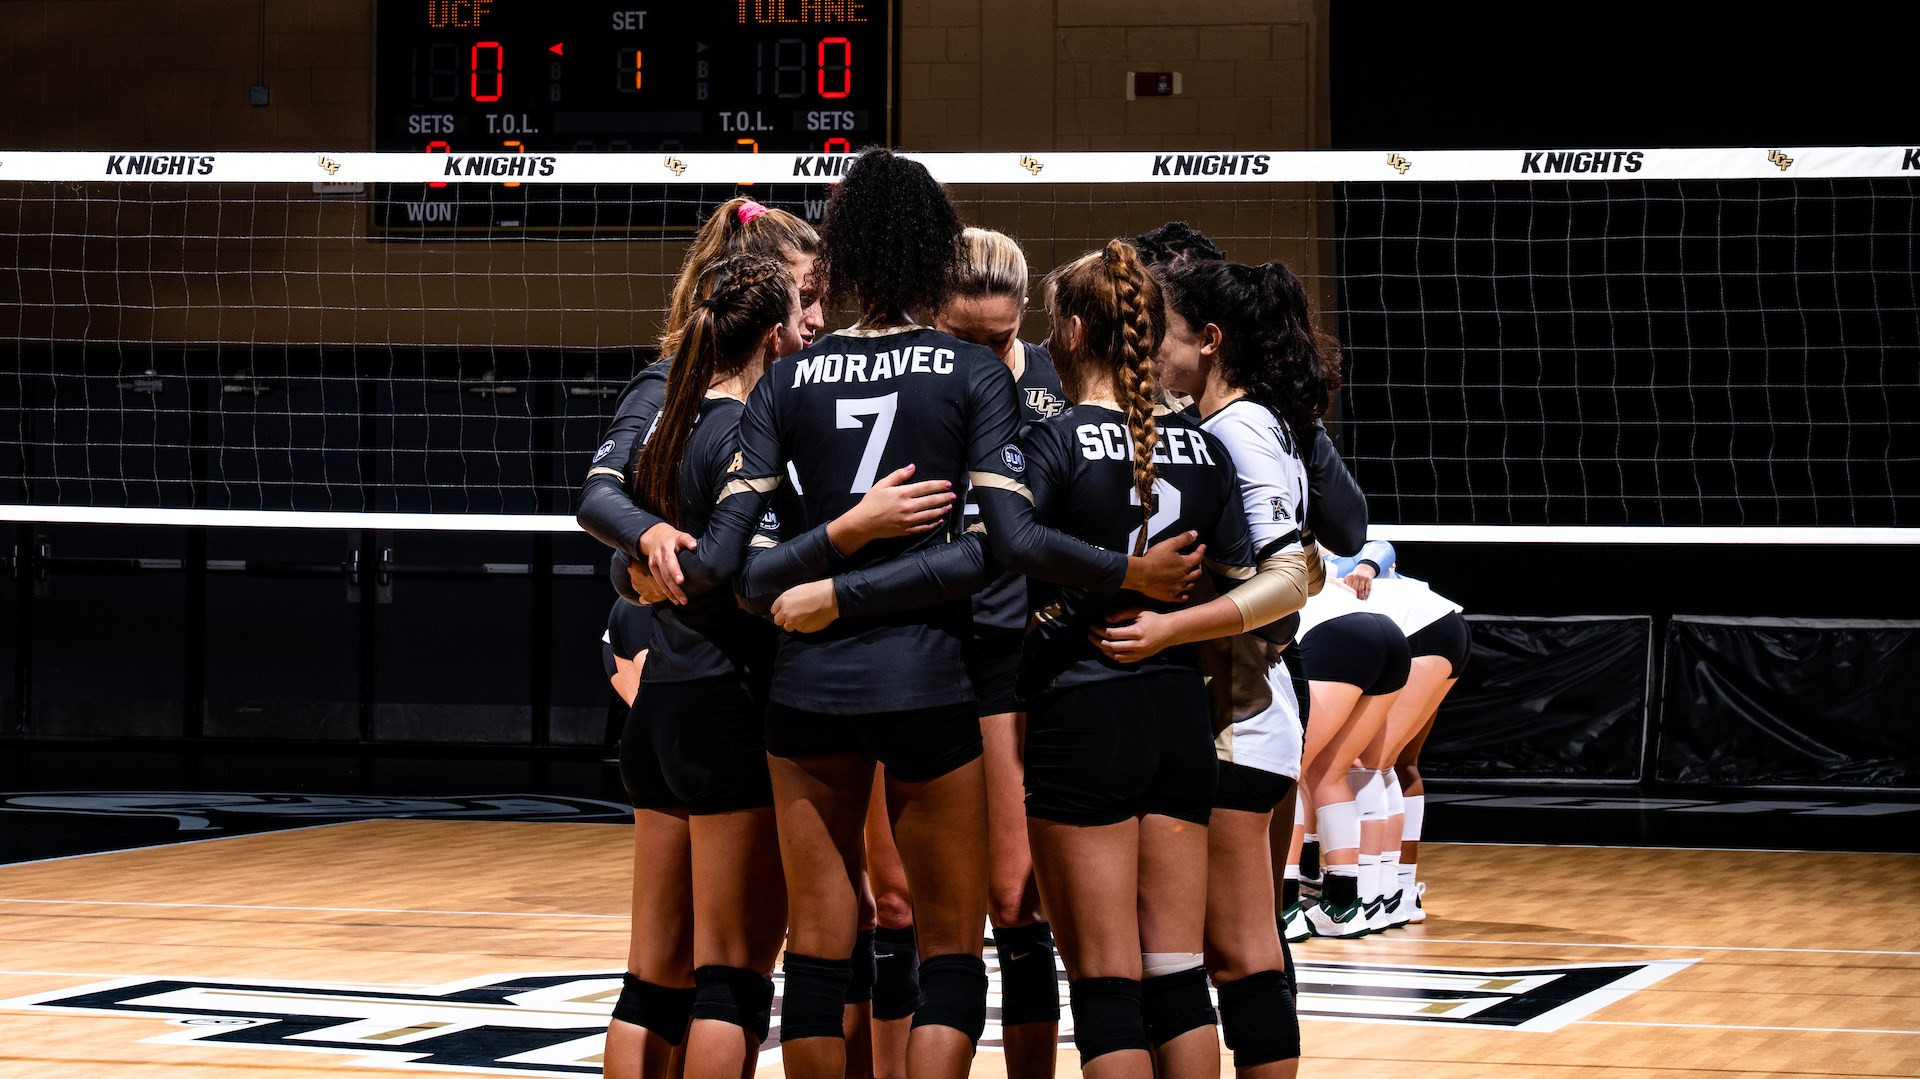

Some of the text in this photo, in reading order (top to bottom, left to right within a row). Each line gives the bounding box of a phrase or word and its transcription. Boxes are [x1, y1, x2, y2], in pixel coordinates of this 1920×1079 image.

[429, 0, 493, 27] UCF
[612, 11, 647, 30] SET
[471, 41, 503, 102] 0
[636, 50, 642, 90] 1
[818, 37, 851, 98] 0
[408, 114, 455, 133] SETS
[486, 114, 539, 133] T.O.L.
[719, 111, 774, 131] T.O.L.
[807, 111, 855, 130] SETS
[105, 155, 215, 175] KNIGHTS
[318, 155, 341, 175] UCF
[444, 156, 556, 176] KNIGHTS
[664, 156, 687, 176] UCF
[1019, 155, 1044, 176] UCF
[1152, 154, 1271, 176] KNIGHTS
[1387, 153, 1412, 175] UCF
[1521, 151, 1644, 173] KNIGHTS
[1767, 150, 1794, 171] UCF
[406, 202, 451, 221] WON
[791, 346, 955, 389] MORAVEC
[1024, 388, 1065, 418] UCF
[836, 391, 898, 493] 7
